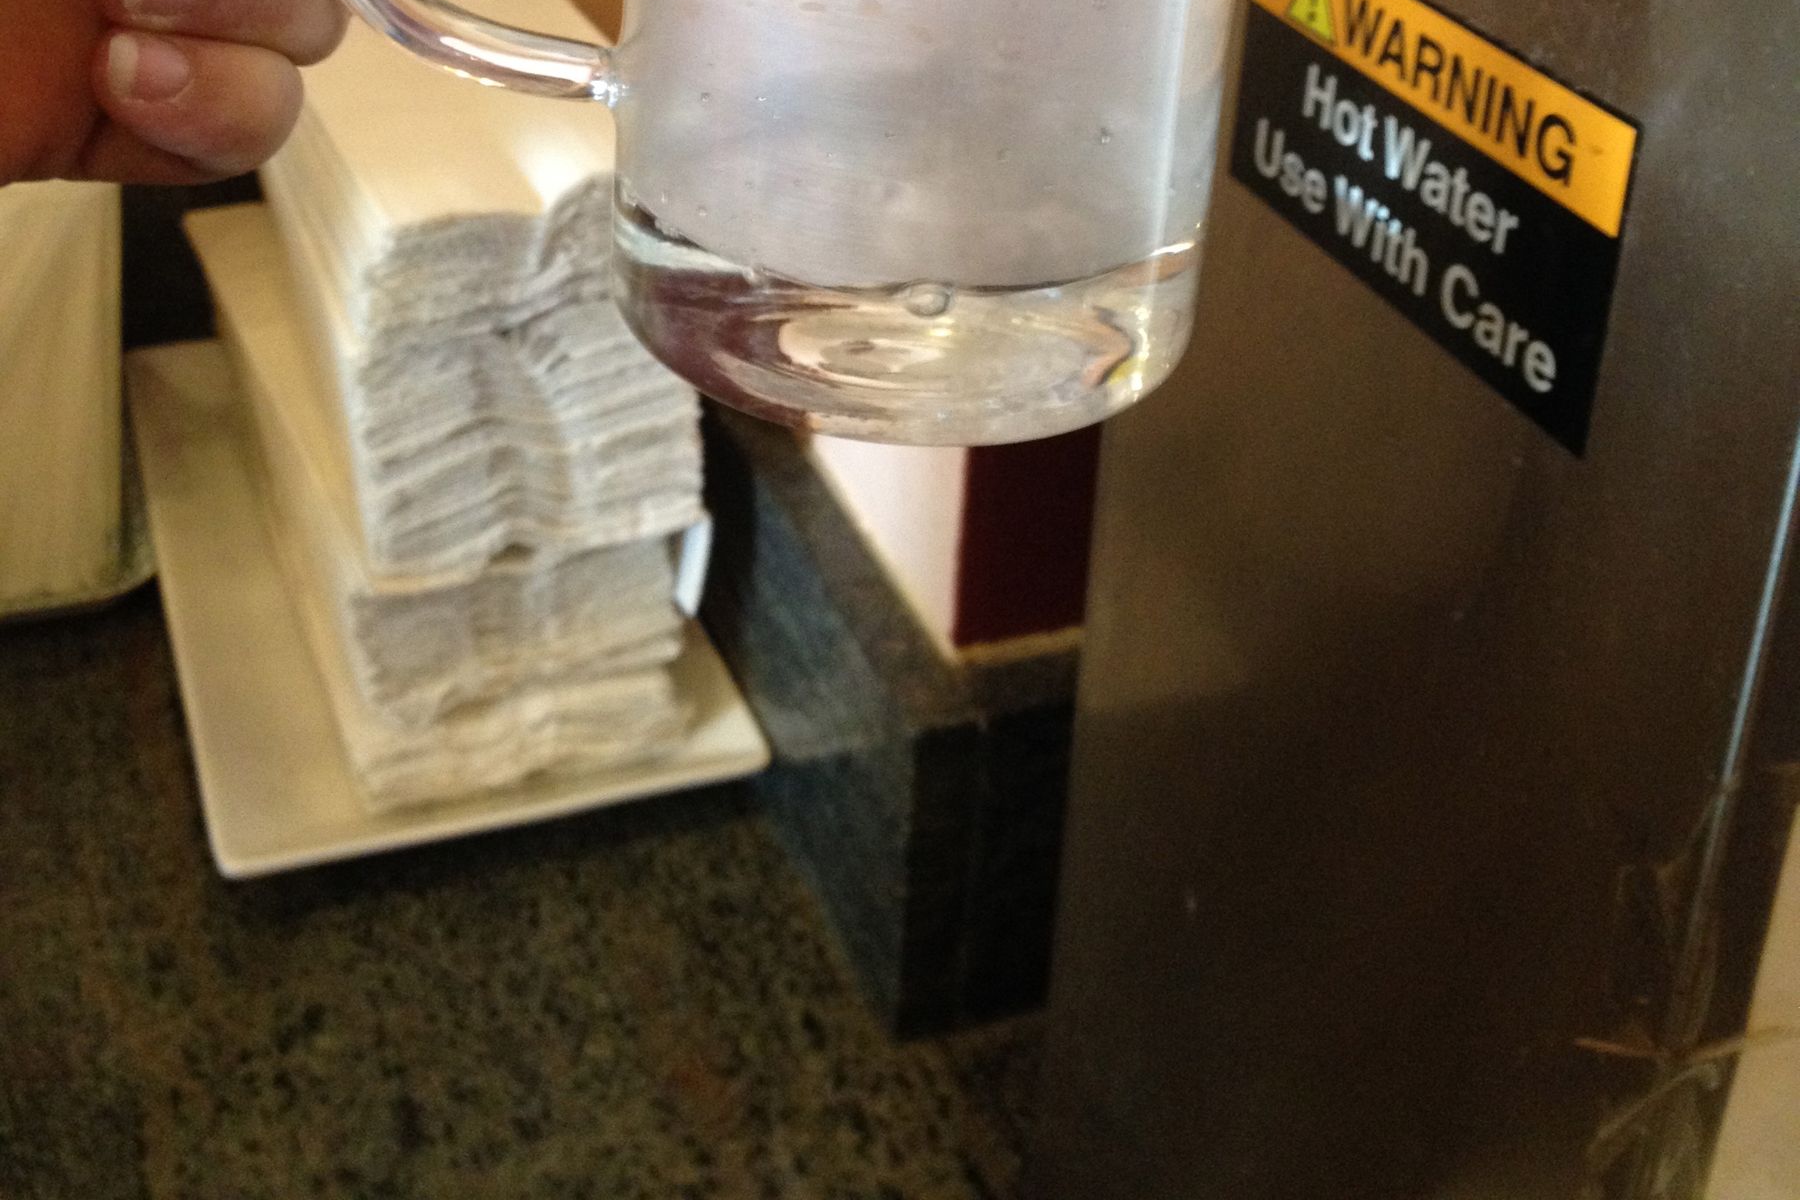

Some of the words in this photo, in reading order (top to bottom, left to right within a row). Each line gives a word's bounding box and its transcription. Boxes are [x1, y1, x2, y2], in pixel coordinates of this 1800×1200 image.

[1254, 117, 1328, 214] Use
[1334, 174, 1429, 296] With
[1440, 263, 1557, 393] Care
[1302, 63, 1379, 161] Hot
[1382, 115, 1520, 255] Water
